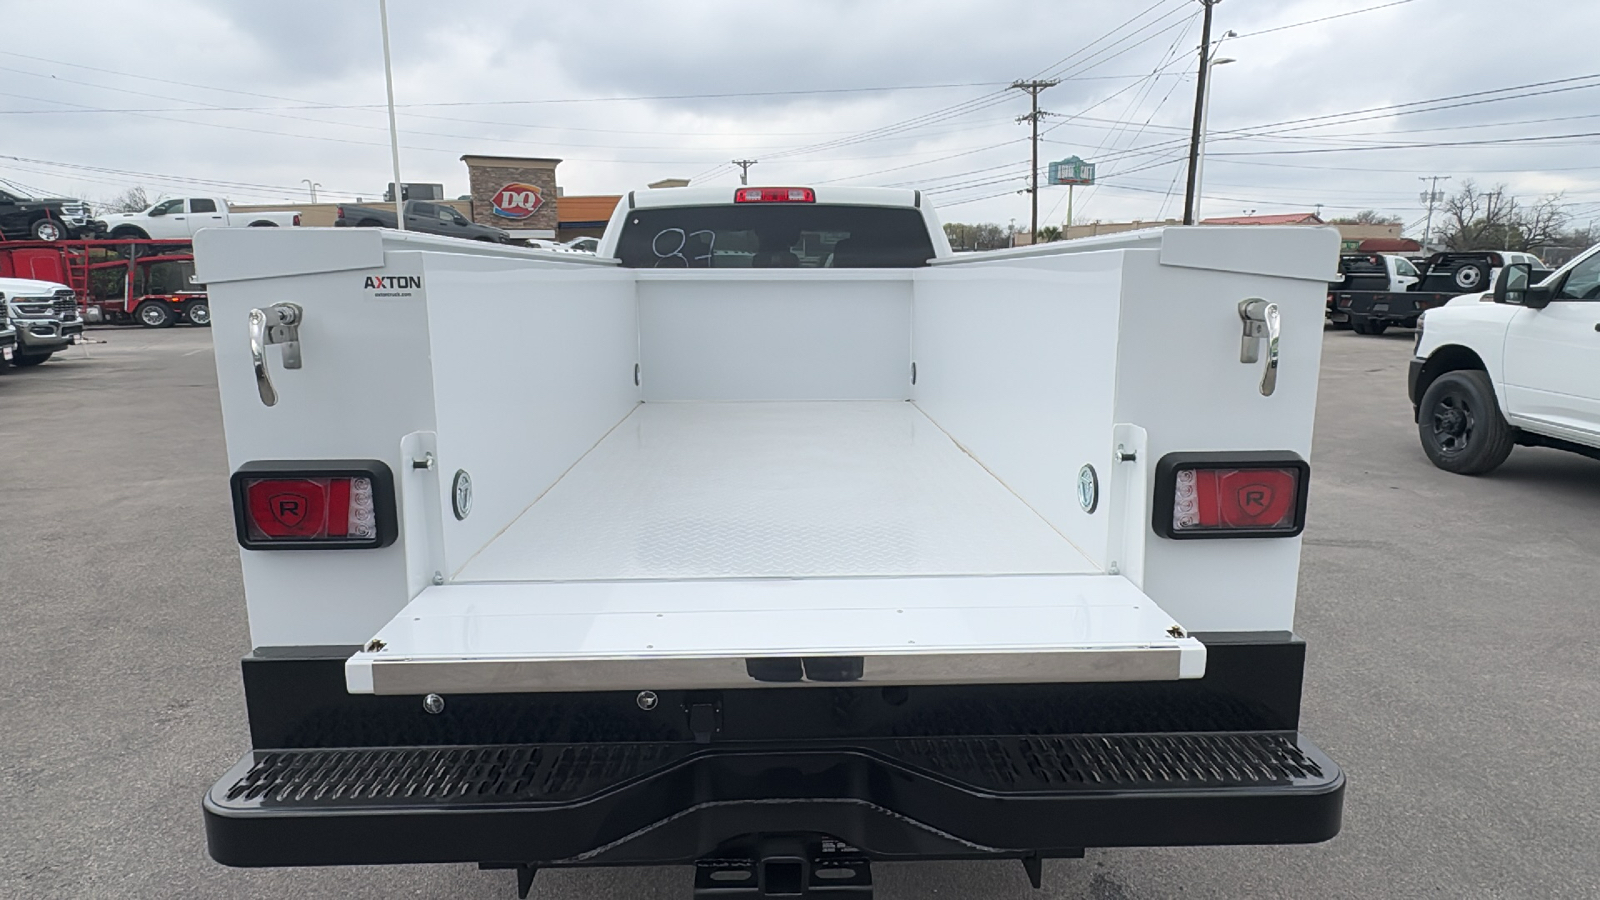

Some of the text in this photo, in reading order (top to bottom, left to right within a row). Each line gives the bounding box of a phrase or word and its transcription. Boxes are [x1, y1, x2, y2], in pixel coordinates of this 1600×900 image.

[501, 191, 536, 211] DQ
[364, 276, 422, 289] AXTON
[1246, 491, 1265, 507] R
[279, 501, 299, 516] R
